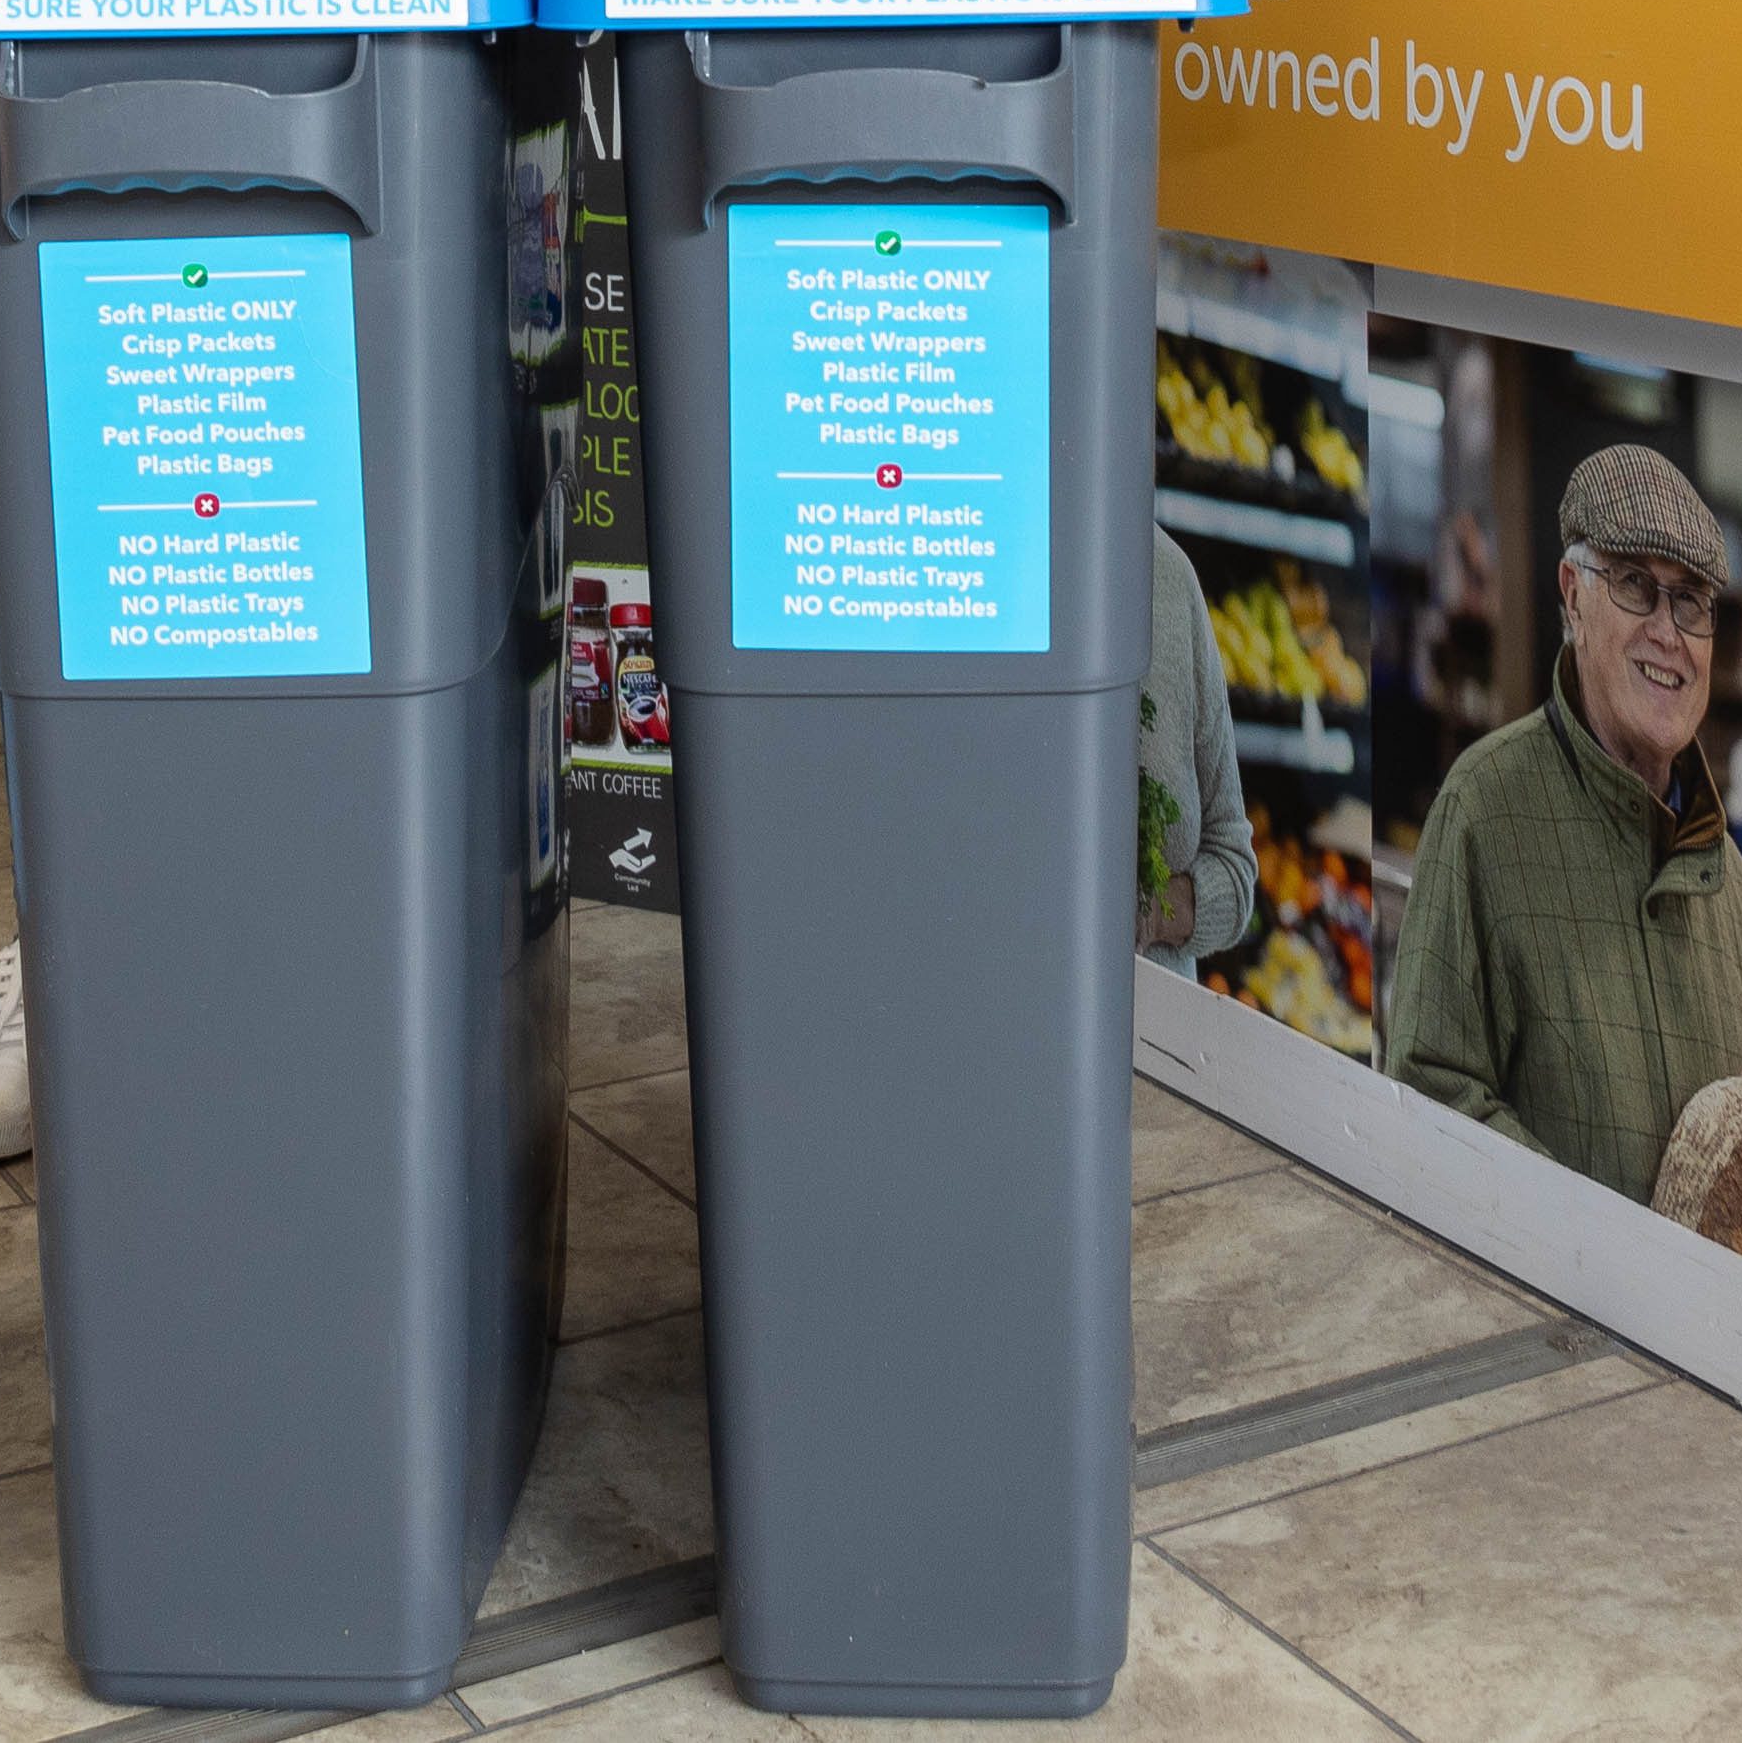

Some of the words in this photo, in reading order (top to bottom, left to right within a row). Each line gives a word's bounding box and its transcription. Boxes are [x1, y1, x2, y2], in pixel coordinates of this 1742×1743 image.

[1175, 37, 1380, 122] owned
[1405, 40, 1484, 155] by
[1504, 72, 1643, 162] you
[787, 270, 836, 290] Soft
[841, 269, 918, 290] Plastic
[923, 270, 991, 290] ONLY
[98, 303, 145, 325] Soft
[151, 301, 226, 323] Plastic
[231, 300, 297, 321] ONLY
[809, 301, 871, 326] Crisp
[877, 300, 968, 322] Packets
[122, 333, 182, 357] Crisp
[188, 330, 276, 353] Packets
[792, 332, 865, 352] Sweet
[870, 332, 986, 356] Wrappers
[105, 364, 177, 386] Sweet
[182, 362, 295, 385] Wrappers
[823, 363, 900, 383] Plastic
[905, 363, 955, 383] Film
[137, 394, 212, 415] Plastic
[218, 392, 266, 413] Film
[785, 393, 824, 413] Pet
[830, 393, 889, 414] Food
[896, 393, 994, 414] Pouches
[102, 426, 140, 446] Pet
[145, 425, 204, 445] Food
[210, 423, 306, 443] Pouches
[820, 424, 896, 445] Plastic
[902, 425, 959, 449] Bags
[137, 455, 212, 476] Plastic
[217, 454, 273, 478] Bags
[797, 505, 836, 524] NO
[842, 504, 900, 524] Hard
[906, 505, 983, 525] Plastic
[784, 535, 824, 555] NO
[830, 535, 907, 556] Plastic
[912, 536, 995, 557] Bottles
[796, 566, 836, 585] NO
[841, 566, 918, 587] Plastic
[923, 567, 984, 590] Trays
[784, 596, 823, 615] NO
[829, 596, 998, 621] Compostables
[602, 773, 662, 800] COFFEE
